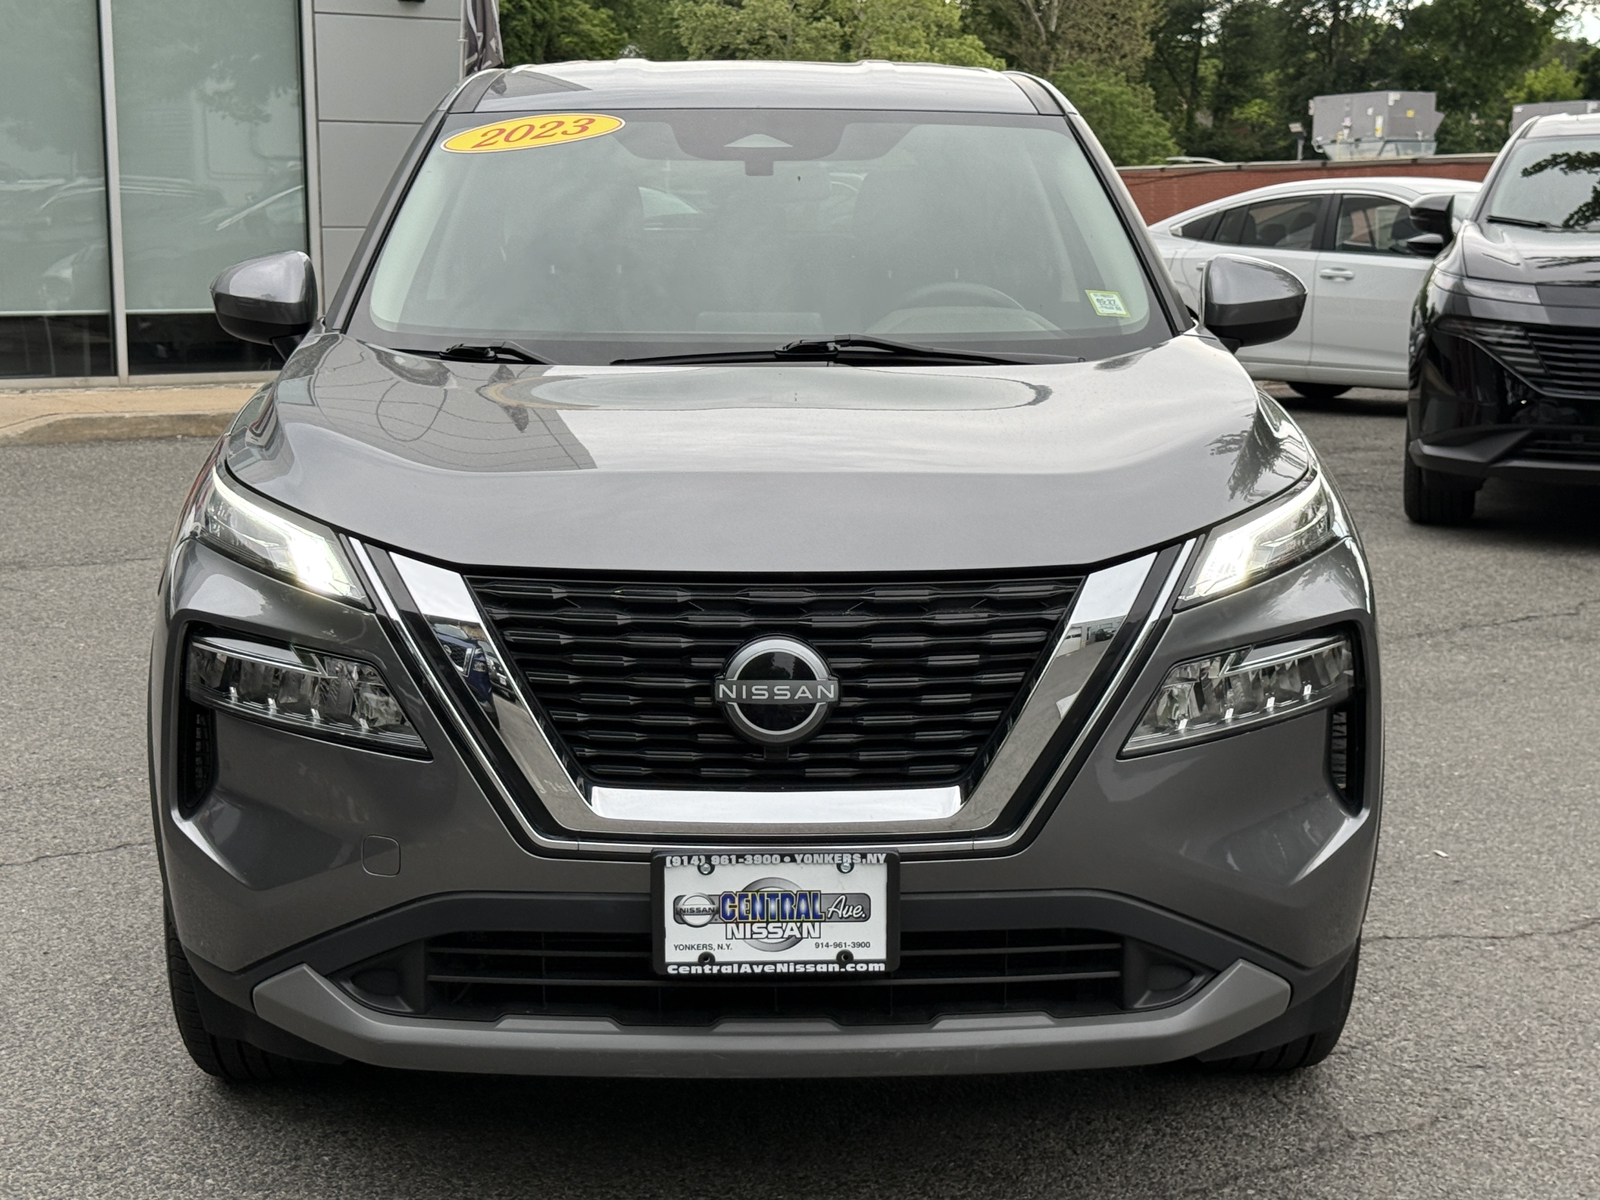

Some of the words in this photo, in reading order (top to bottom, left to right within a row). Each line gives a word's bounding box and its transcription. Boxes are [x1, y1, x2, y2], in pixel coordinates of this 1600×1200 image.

[470, 118, 596, 149] 2023
[719, 684, 835, 700] NISSAN
[711, 854, 781, 866] 961-3900
[719, 891, 826, 922] CENTRAL
[827, 895, 867, 919] Ave.
[726, 921, 821, 940] NISSAN
[673, 943, 715, 952] YONKERS,
[717, 943, 733, 951] N.Y.
[814, 941, 871, 949] 914-961-3900
